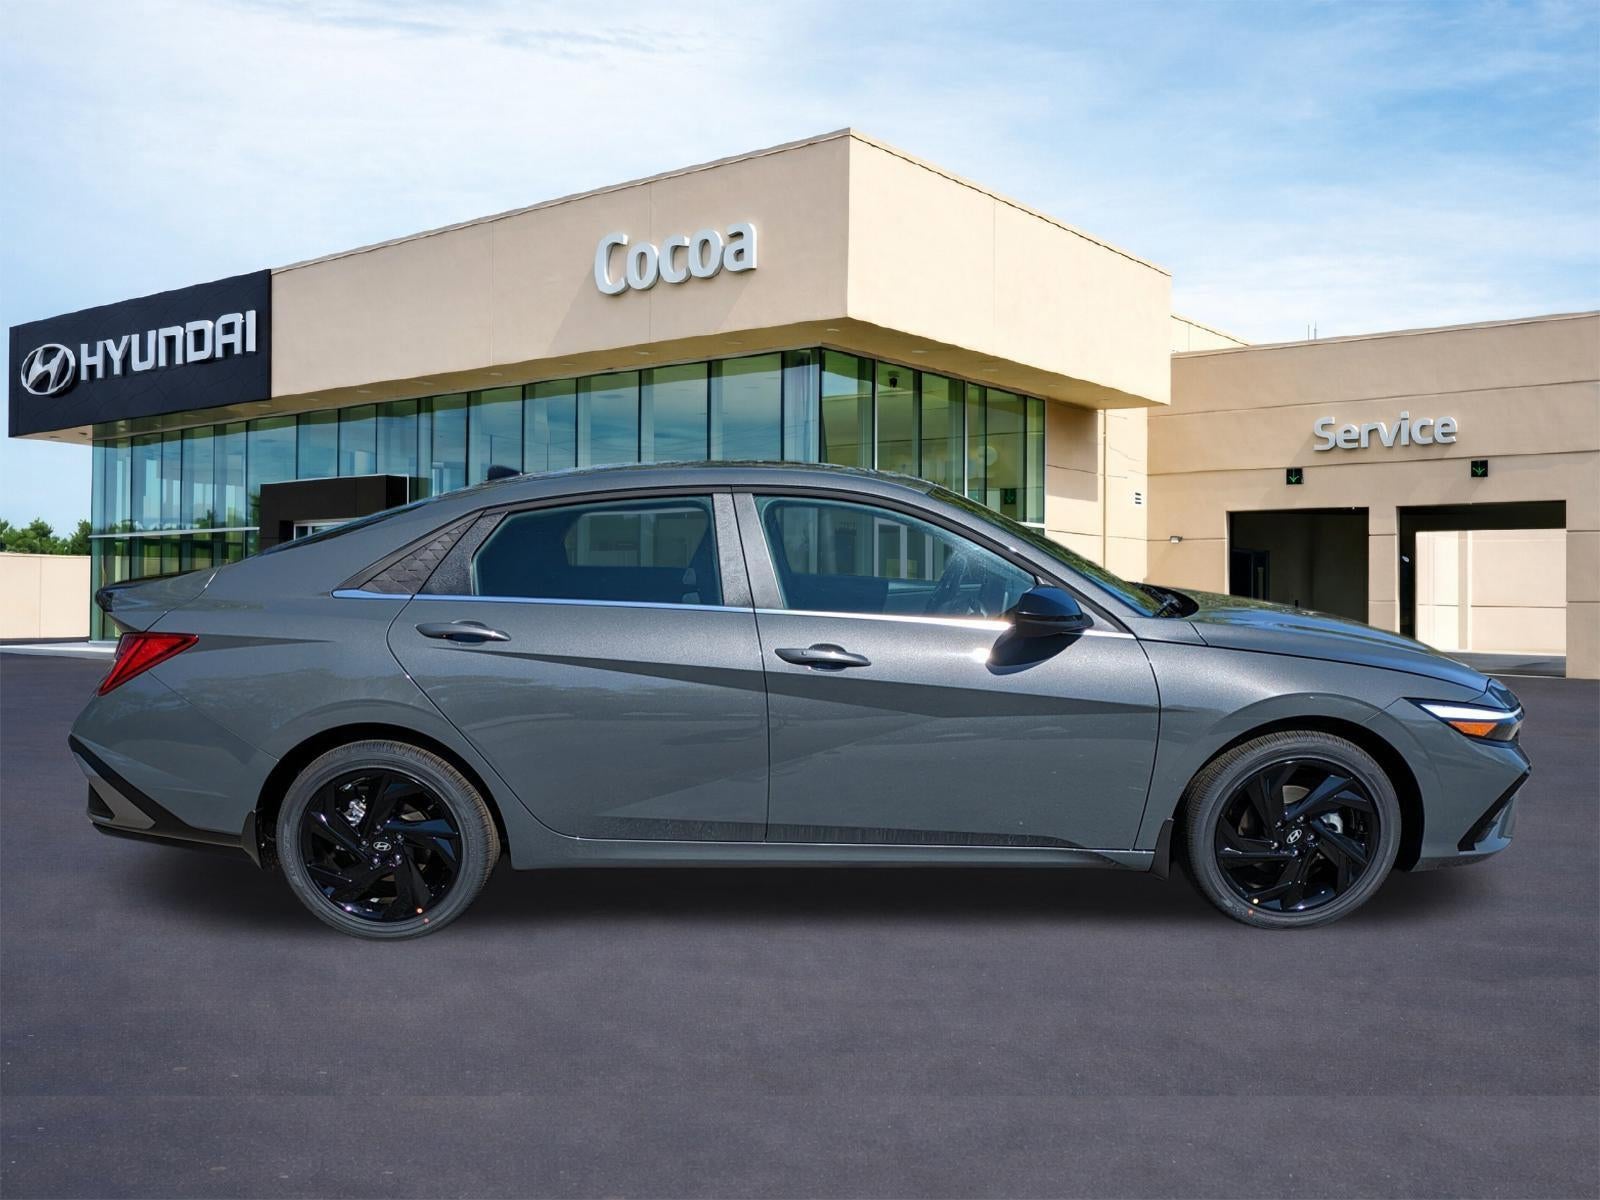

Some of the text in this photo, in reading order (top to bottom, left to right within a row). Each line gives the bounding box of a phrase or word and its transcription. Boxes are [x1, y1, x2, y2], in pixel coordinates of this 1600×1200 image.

[594, 222, 757, 295] Cocoa
[80, 310, 256, 380] HYUNDAI
[1313, 411, 1458, 450] Service
